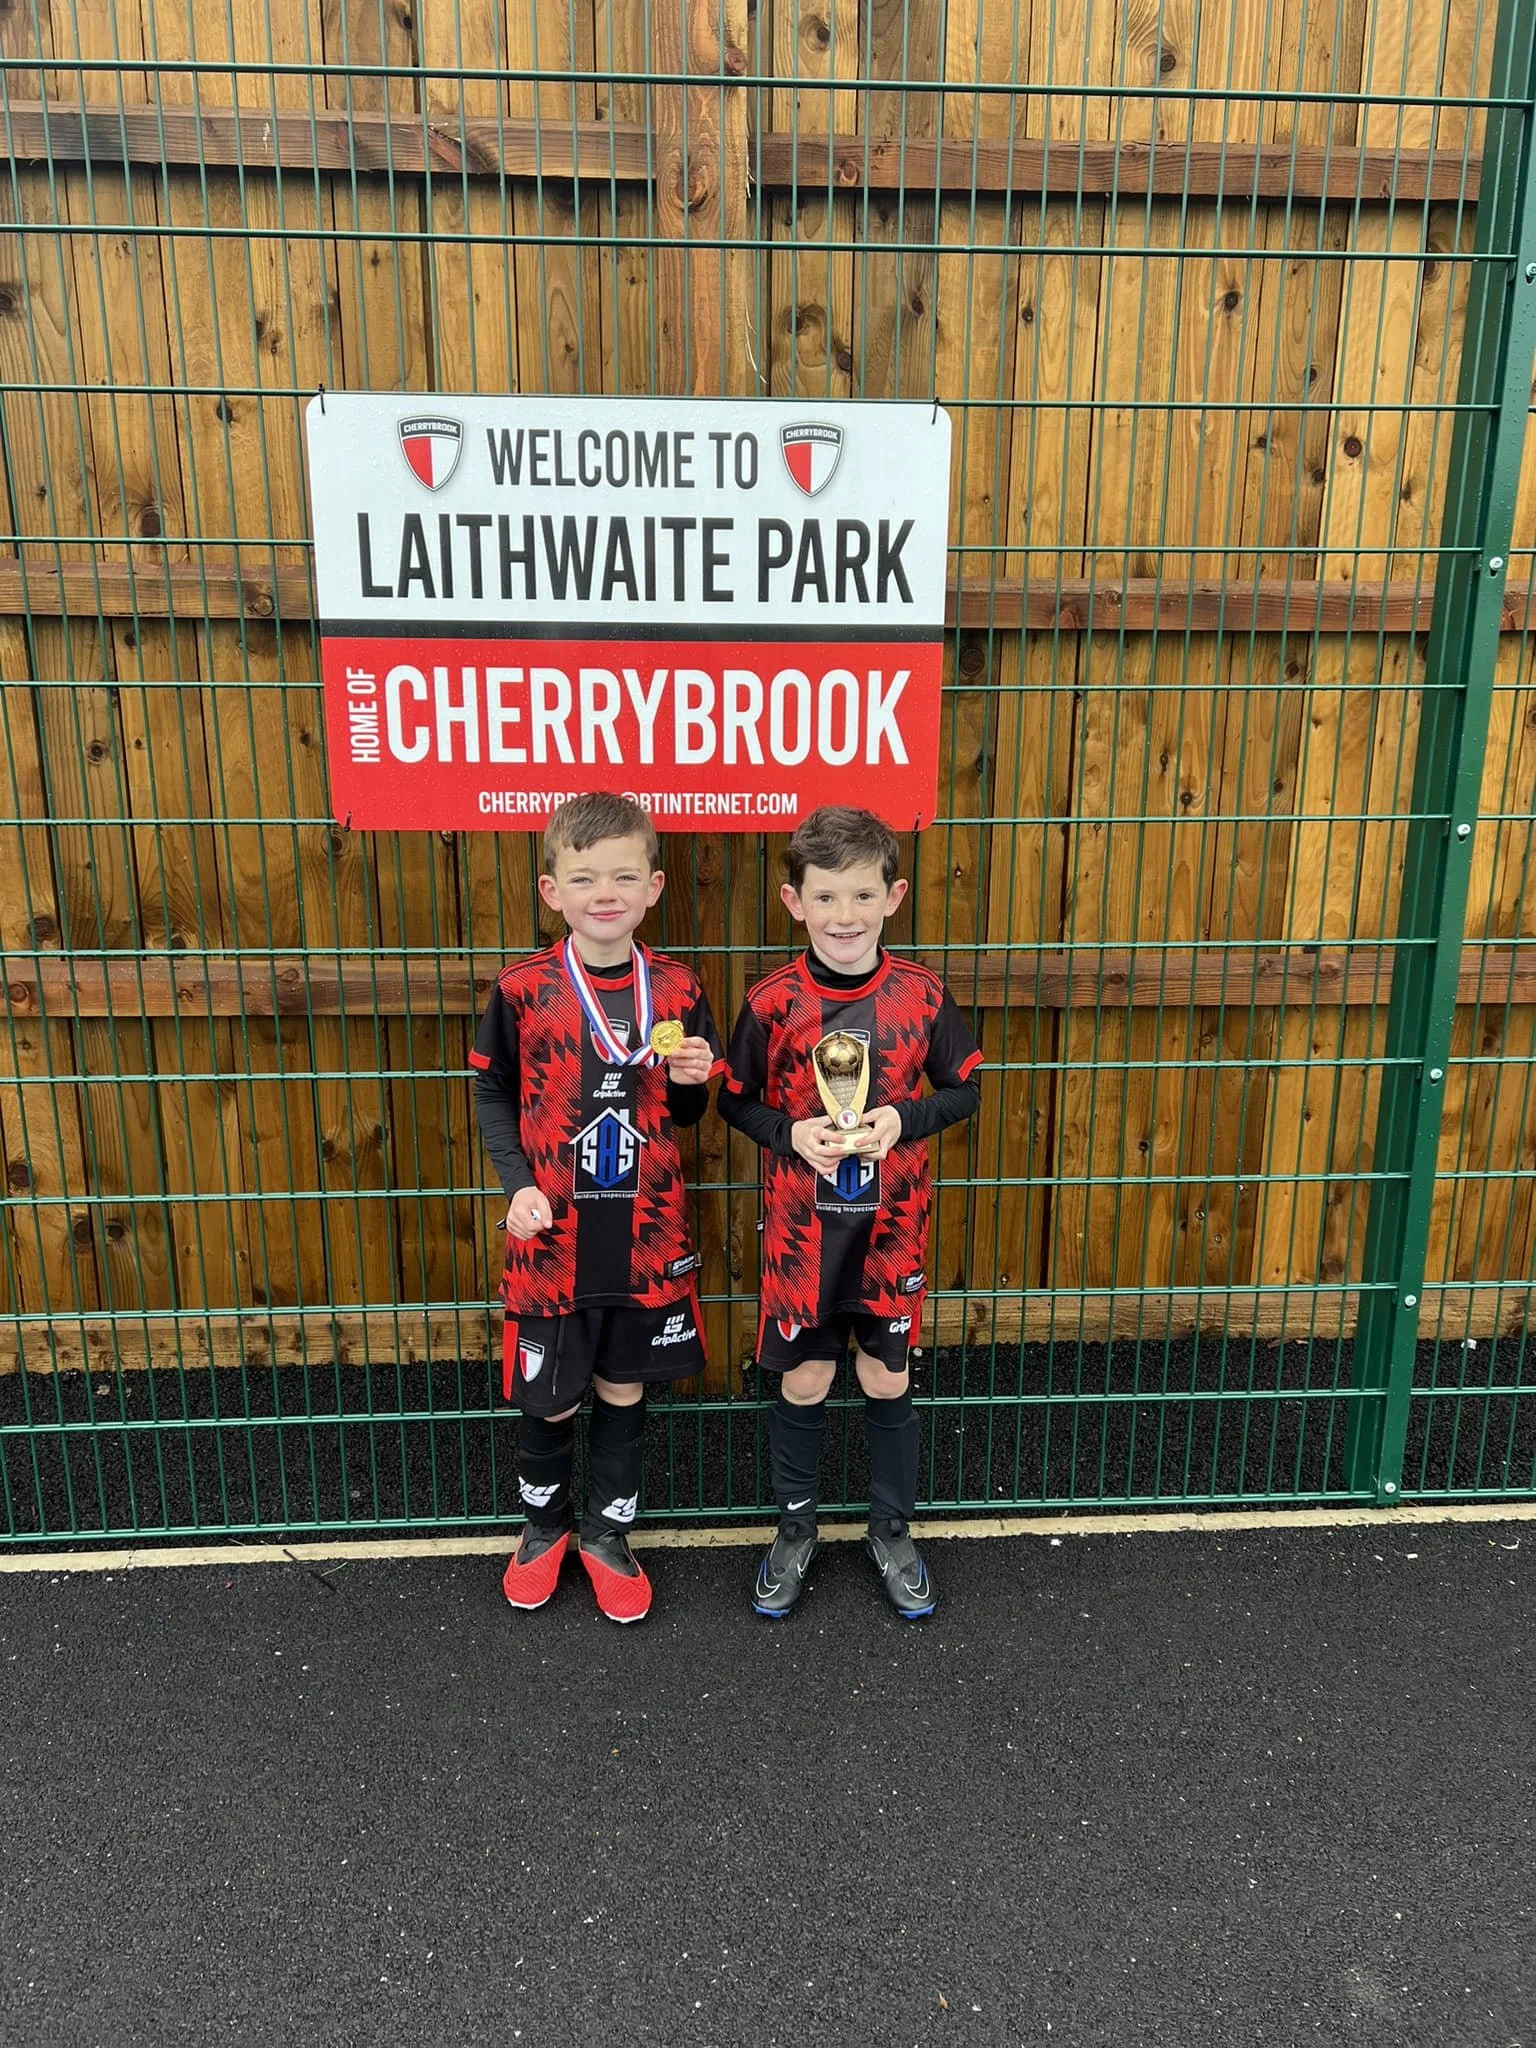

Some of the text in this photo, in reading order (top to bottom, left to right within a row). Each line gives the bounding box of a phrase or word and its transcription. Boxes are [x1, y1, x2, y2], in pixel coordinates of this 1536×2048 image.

[403, 422, 458, 434] CHERRYBROOK
[786, 428, 838, 440] CHERRYBROOK
[487, 429, 758, 489] WELCOME TO
[357, 513, 914, 603] LAITHWAITE PARK
[346, 667, 380, 762] HOME OF
[385, 664, 911, 765] CHERRYBROOK
[651, 1328, 697, 1346] GripActive
